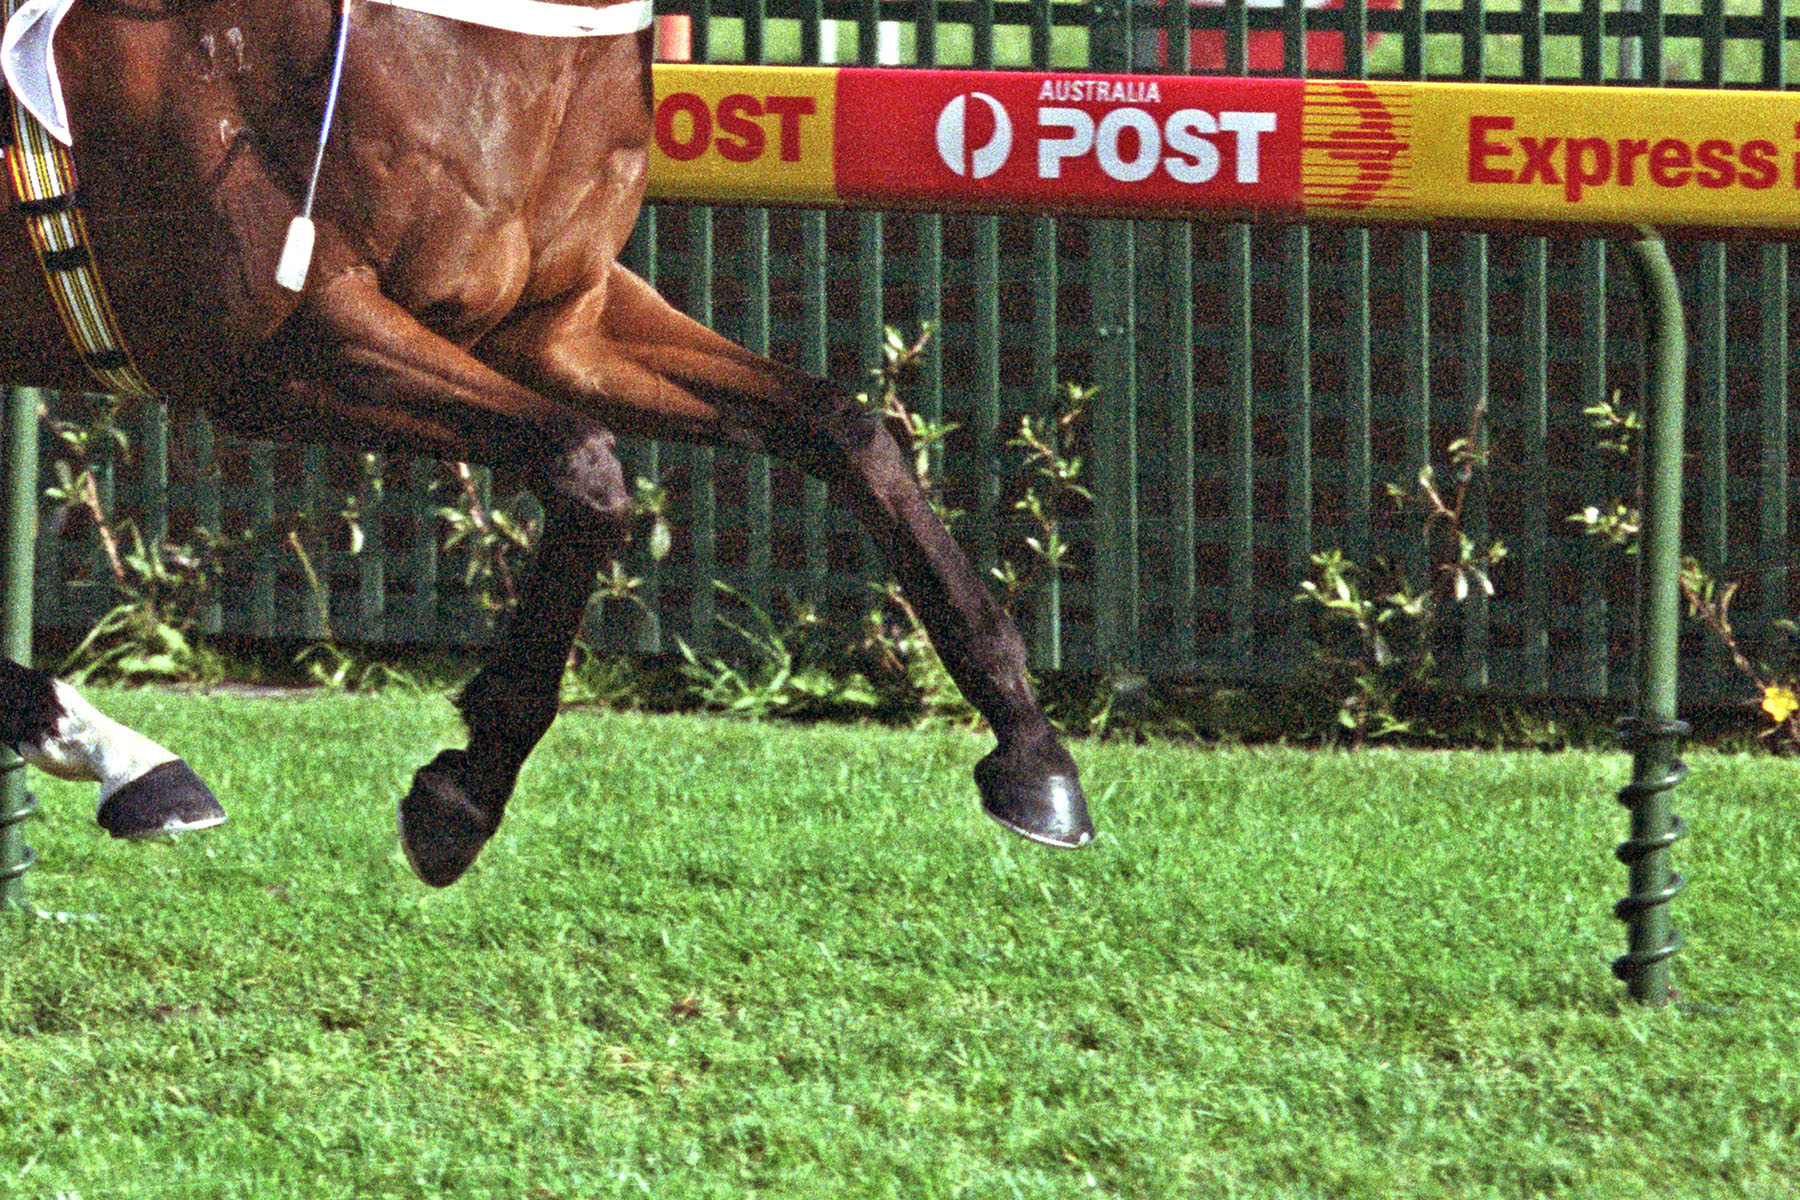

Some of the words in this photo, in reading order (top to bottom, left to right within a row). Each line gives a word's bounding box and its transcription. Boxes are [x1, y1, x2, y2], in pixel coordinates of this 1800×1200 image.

[654, 93, 816, 162] OST
[1039, 80, 1161, 103] AUSTRALIA
[1038, 107, 1277, 183] POST
[1467, 115, 1780, 203] Express
